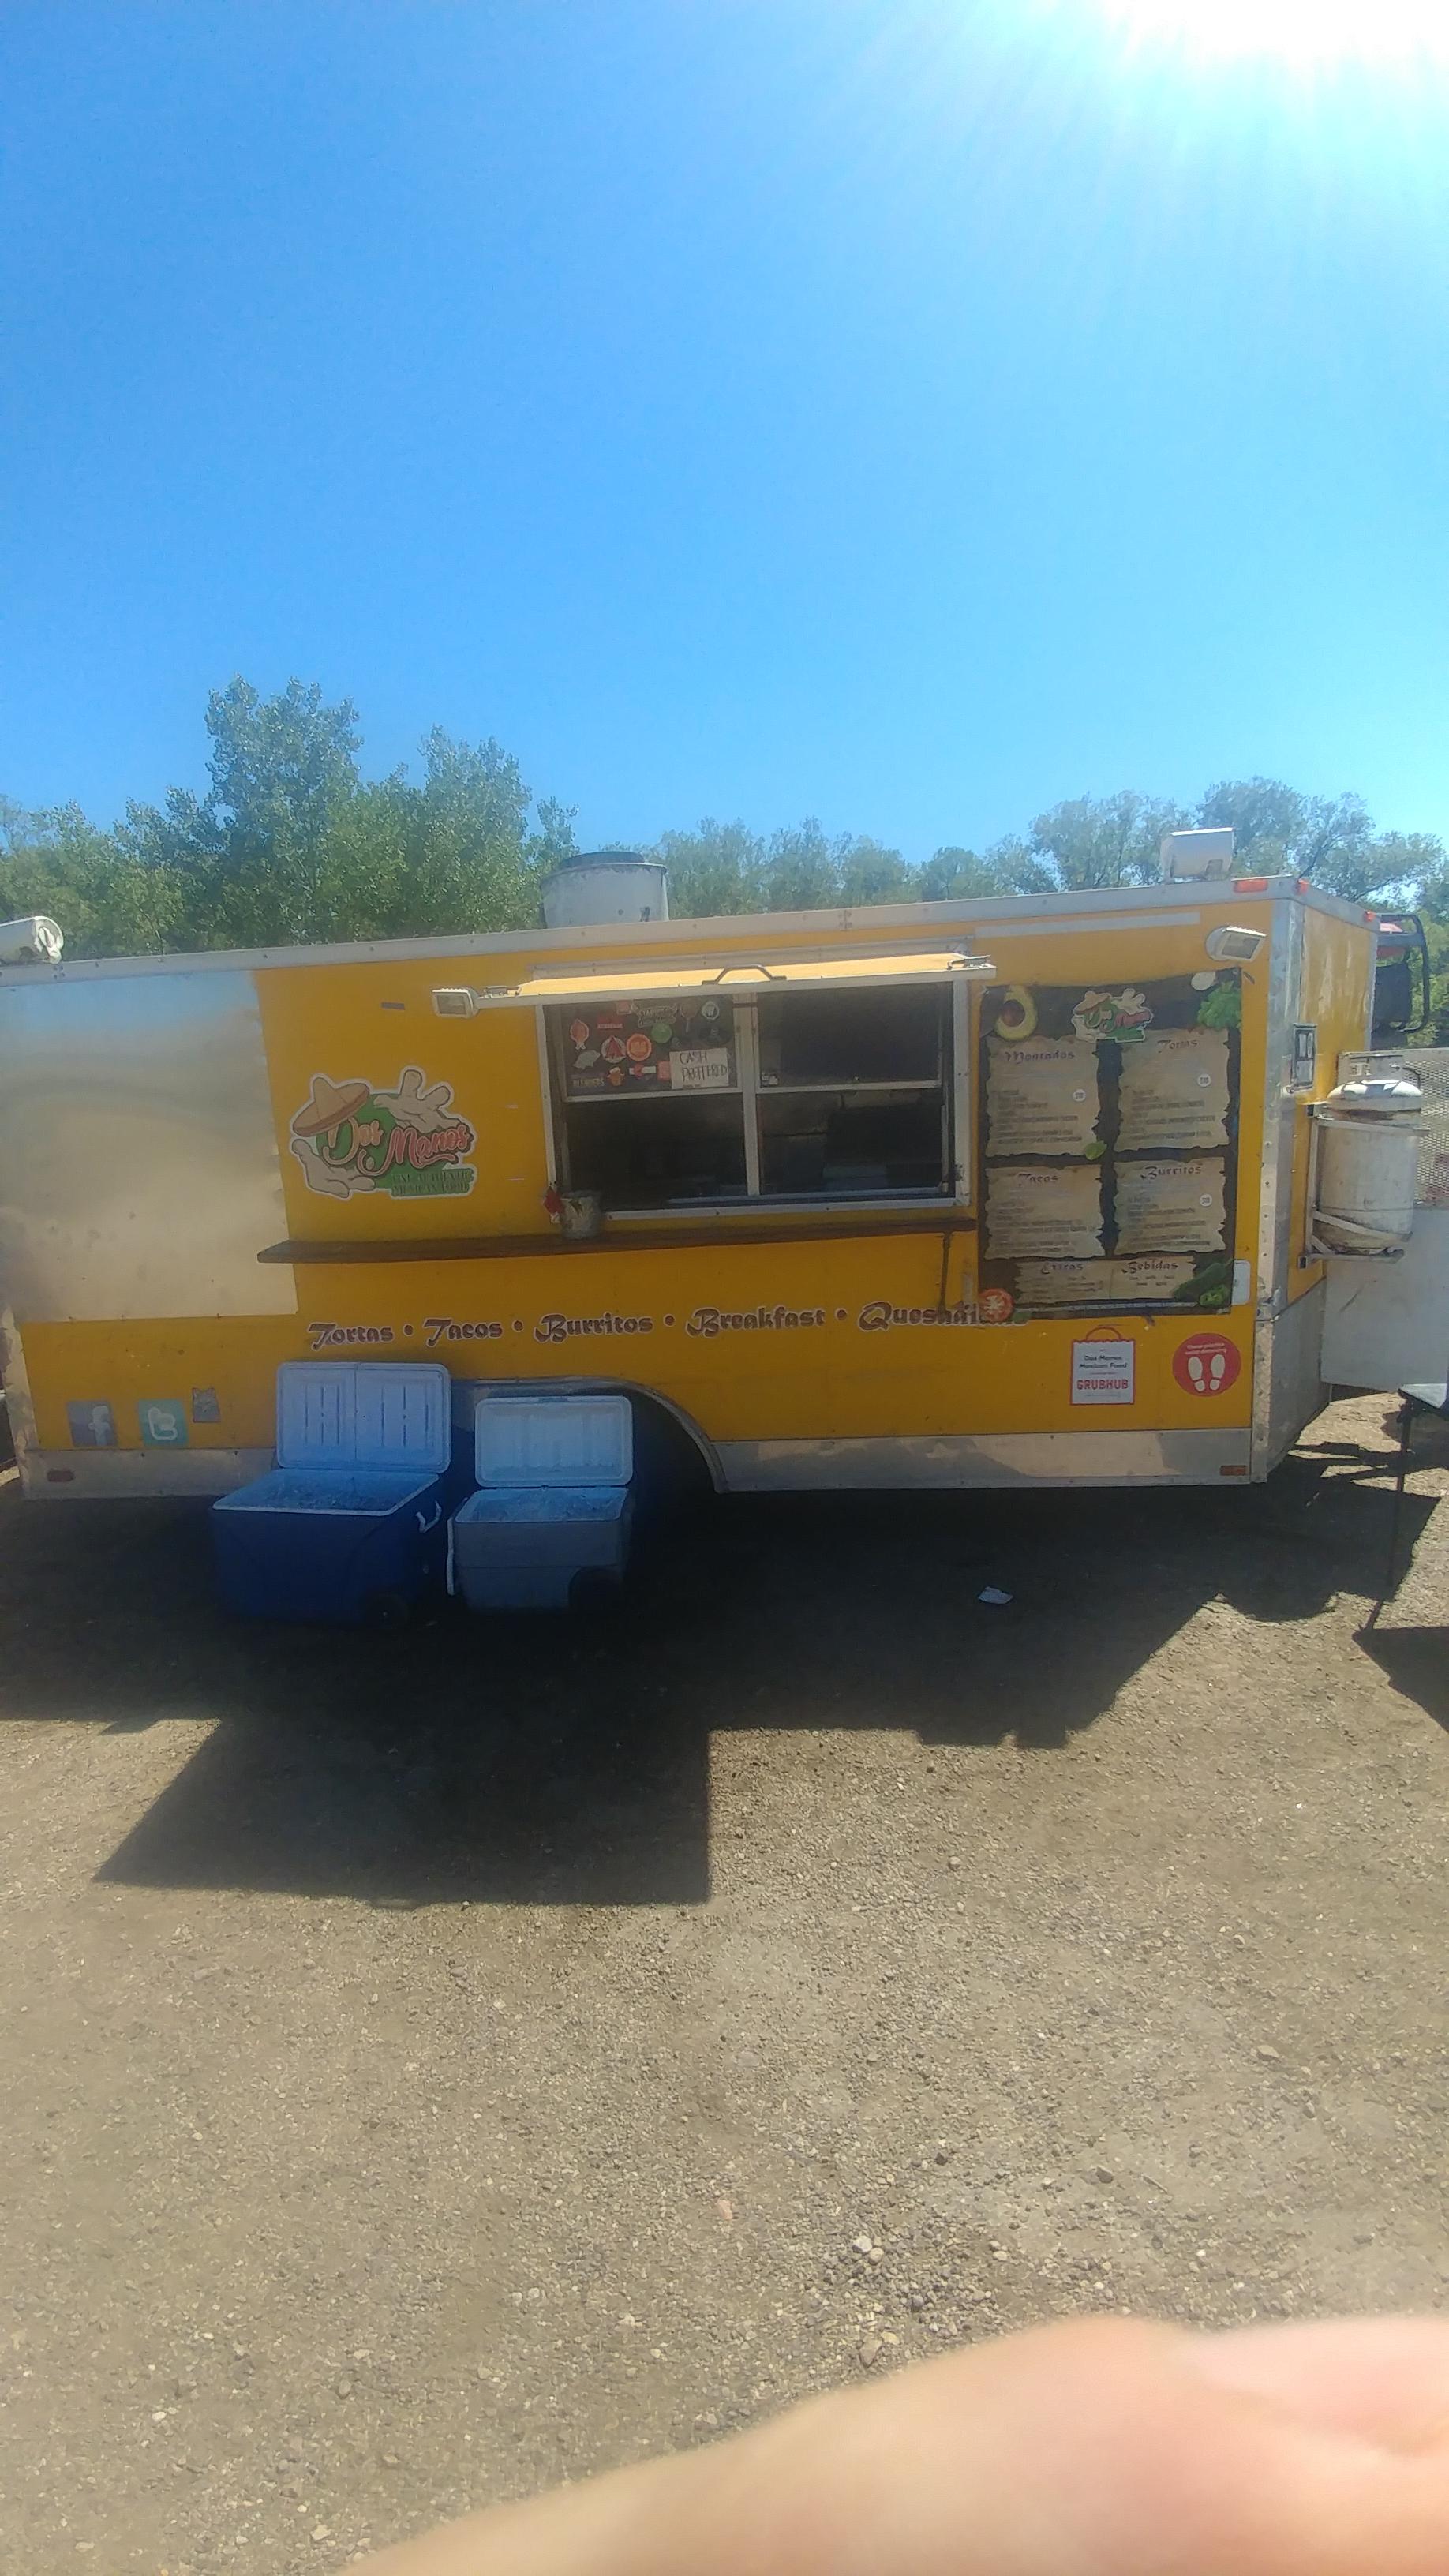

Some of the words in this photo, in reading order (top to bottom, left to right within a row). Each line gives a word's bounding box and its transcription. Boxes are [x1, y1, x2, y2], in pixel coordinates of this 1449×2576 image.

[1157, 1039, 1198, 1054] Tortas
[680, 1050, 707, 1065] CASH
[323, 1117, 383, 1166] Dos
[358, 1122, 469, 1176] Manos
[1140, 1165, 1202, 1179] Burritos
[1018, 1173, 1059, 1187] Tacos
[1121, 1260, 1179, 1275] Bebidas
[309, 1323, 395, 1350] Tortas
[422, 1318, 504, 1347] Tacos
[534, 1312, 653, 1343] Burritos
[686, 1305, 826, 1338] Breakfast
[1076, 1378, 1129, 1391] GRUBHUB
